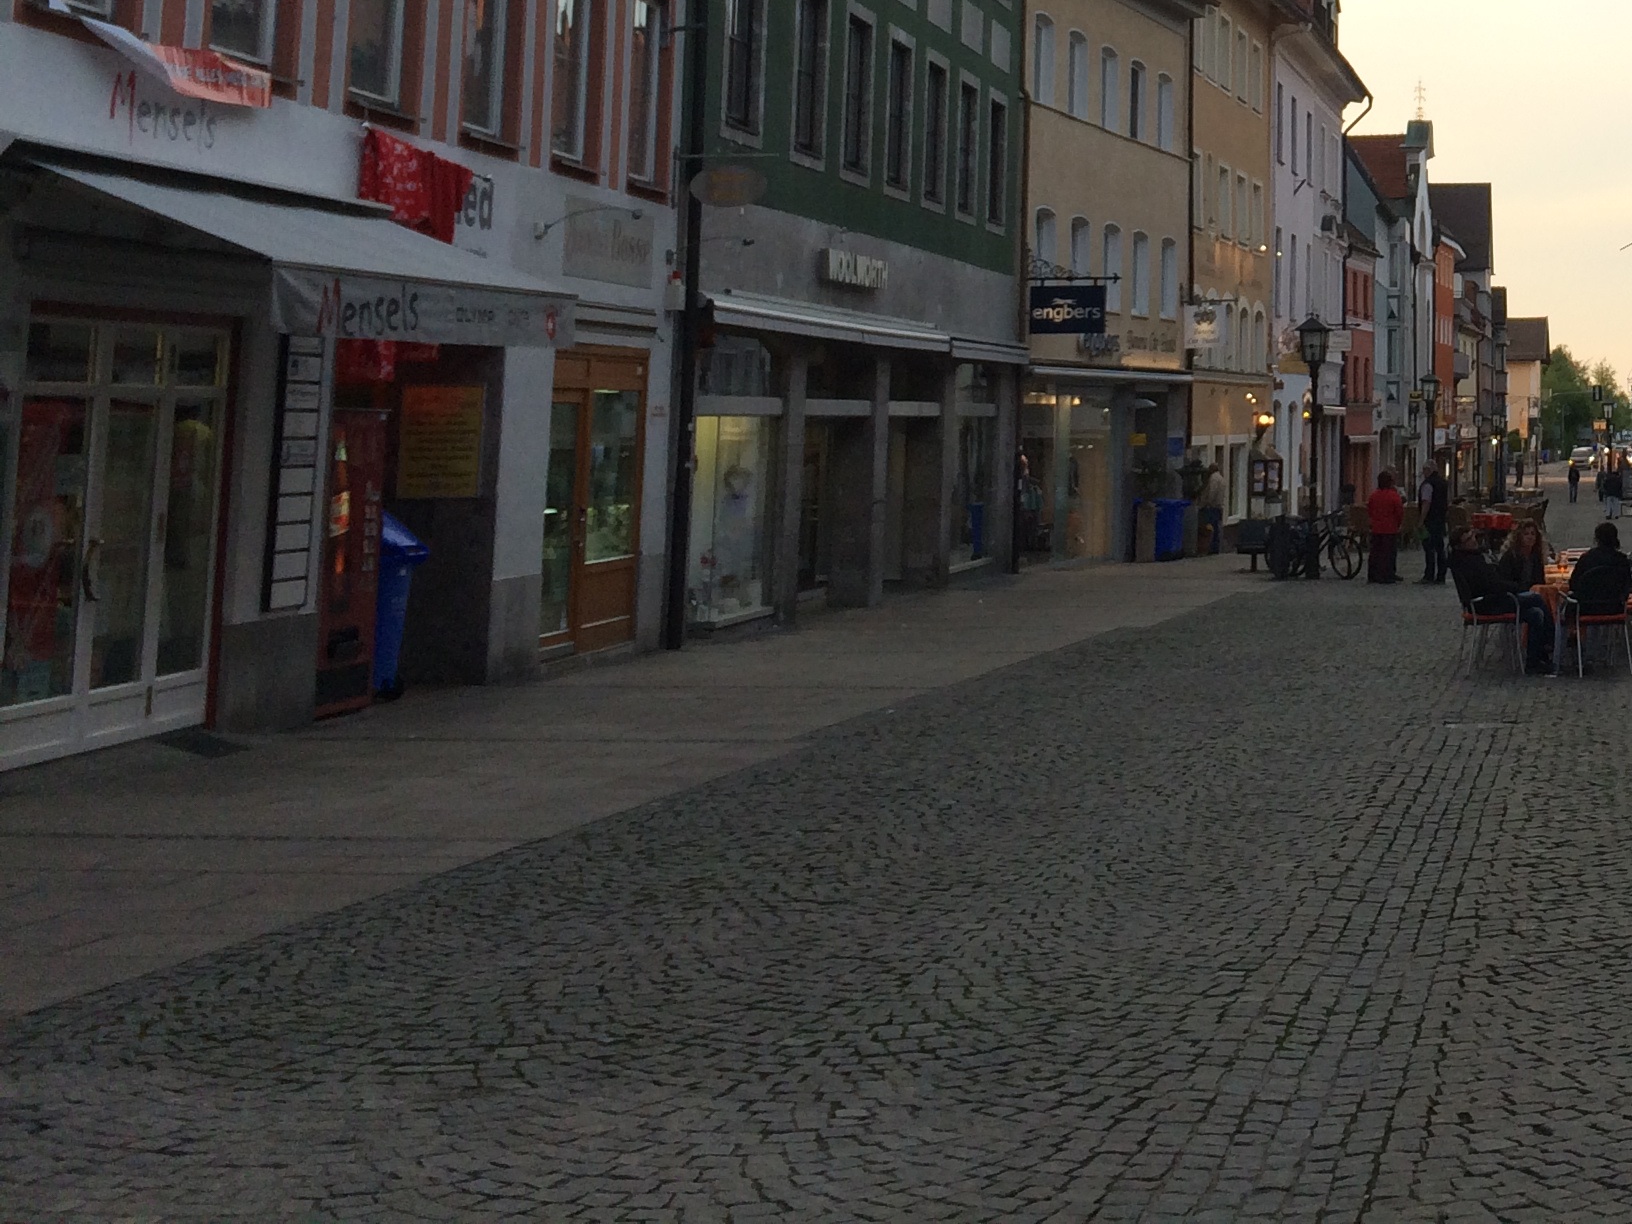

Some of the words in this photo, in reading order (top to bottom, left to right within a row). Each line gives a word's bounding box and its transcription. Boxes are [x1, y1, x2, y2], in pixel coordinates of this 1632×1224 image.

[109, 70, 219, 151] Mensels
[828, 248, 889, 290] WOOLWORTH
[316, 277, 419, 336] Mensels
[1032, 303, 1101, 323] engbers
